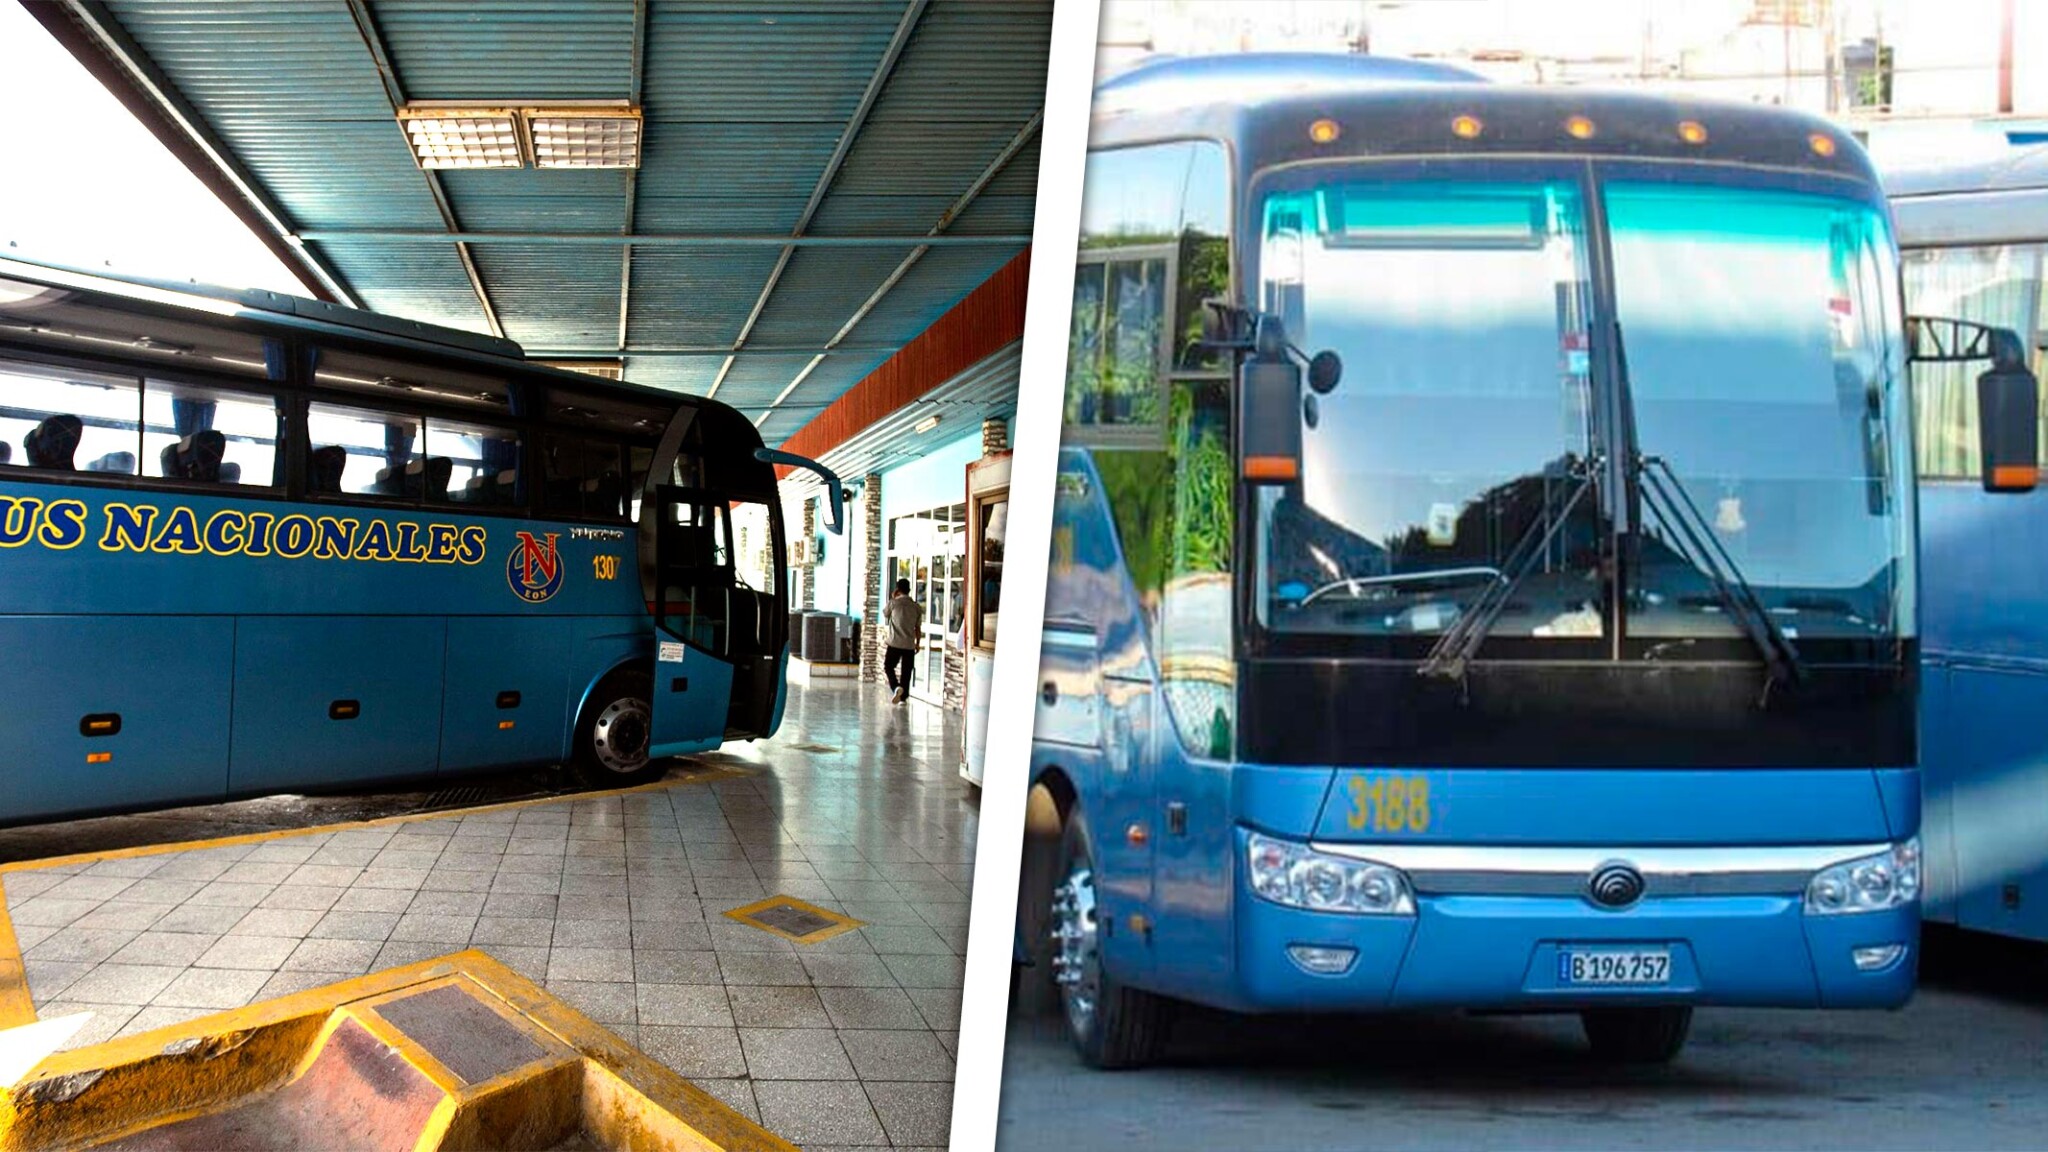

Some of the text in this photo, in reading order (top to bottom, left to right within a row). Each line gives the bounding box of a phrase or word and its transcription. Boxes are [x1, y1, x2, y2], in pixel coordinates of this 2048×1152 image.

[0, 494, 486, 565] US NACIONALES
[516, 531, 561, 584] N
[524, 588, 548, 600] EON
[1347, 775, 1430, 833] 3188
